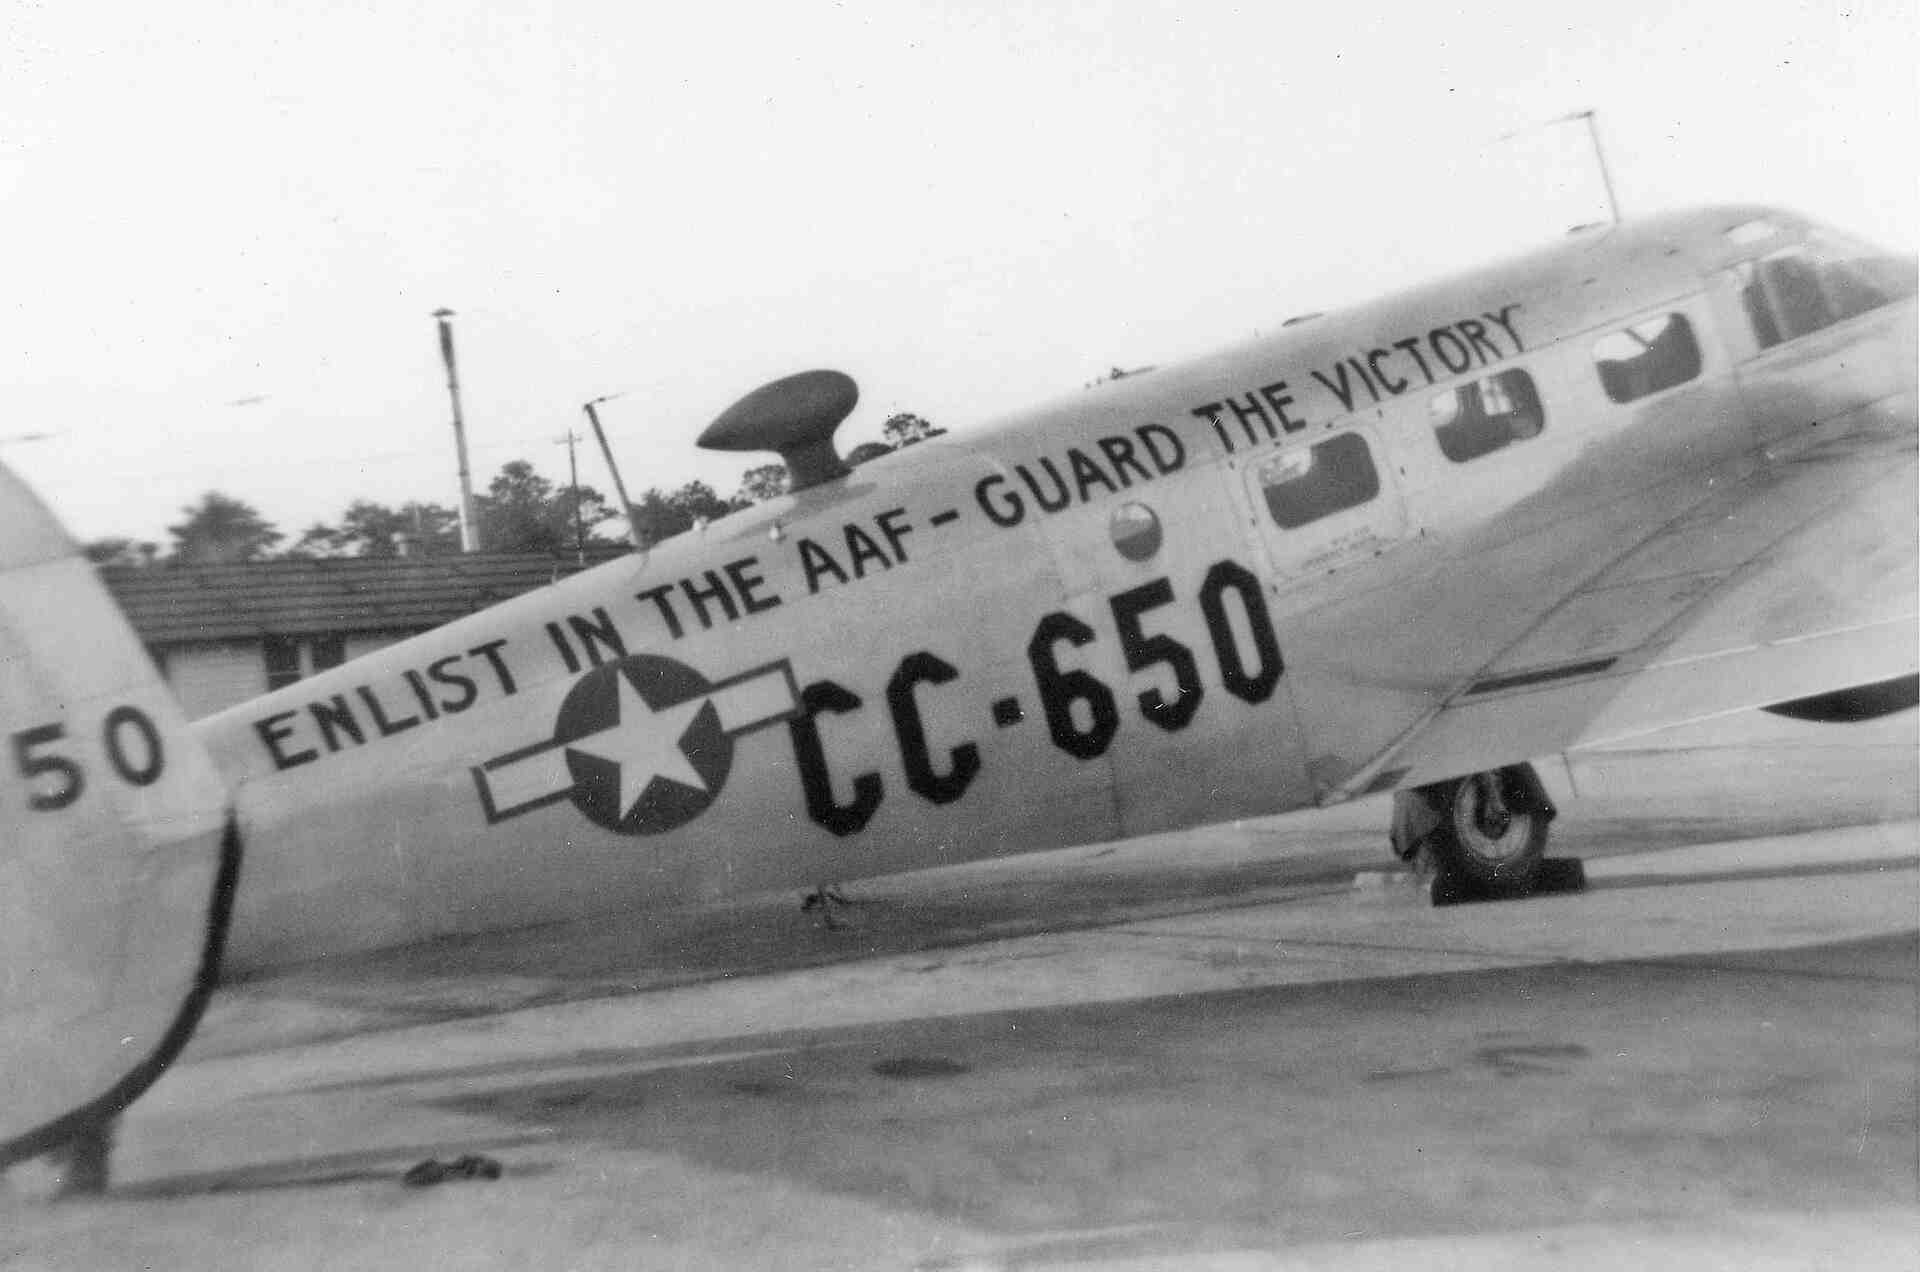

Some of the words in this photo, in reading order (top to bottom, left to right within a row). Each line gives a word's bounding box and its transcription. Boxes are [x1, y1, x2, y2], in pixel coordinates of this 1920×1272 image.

[253, 639, 518, 771] ENLIST
[546, 607, 629, 675] IN
[637, 556, 782, 640] THE
[797, 507, 913, 594] AAF
[974, 423, 1186, 528] GUARD
[1191, 380, 1307, 453] THE
[1310, 303, 1523, 413] VICTORY
[10, 705, 165, 813] 50
